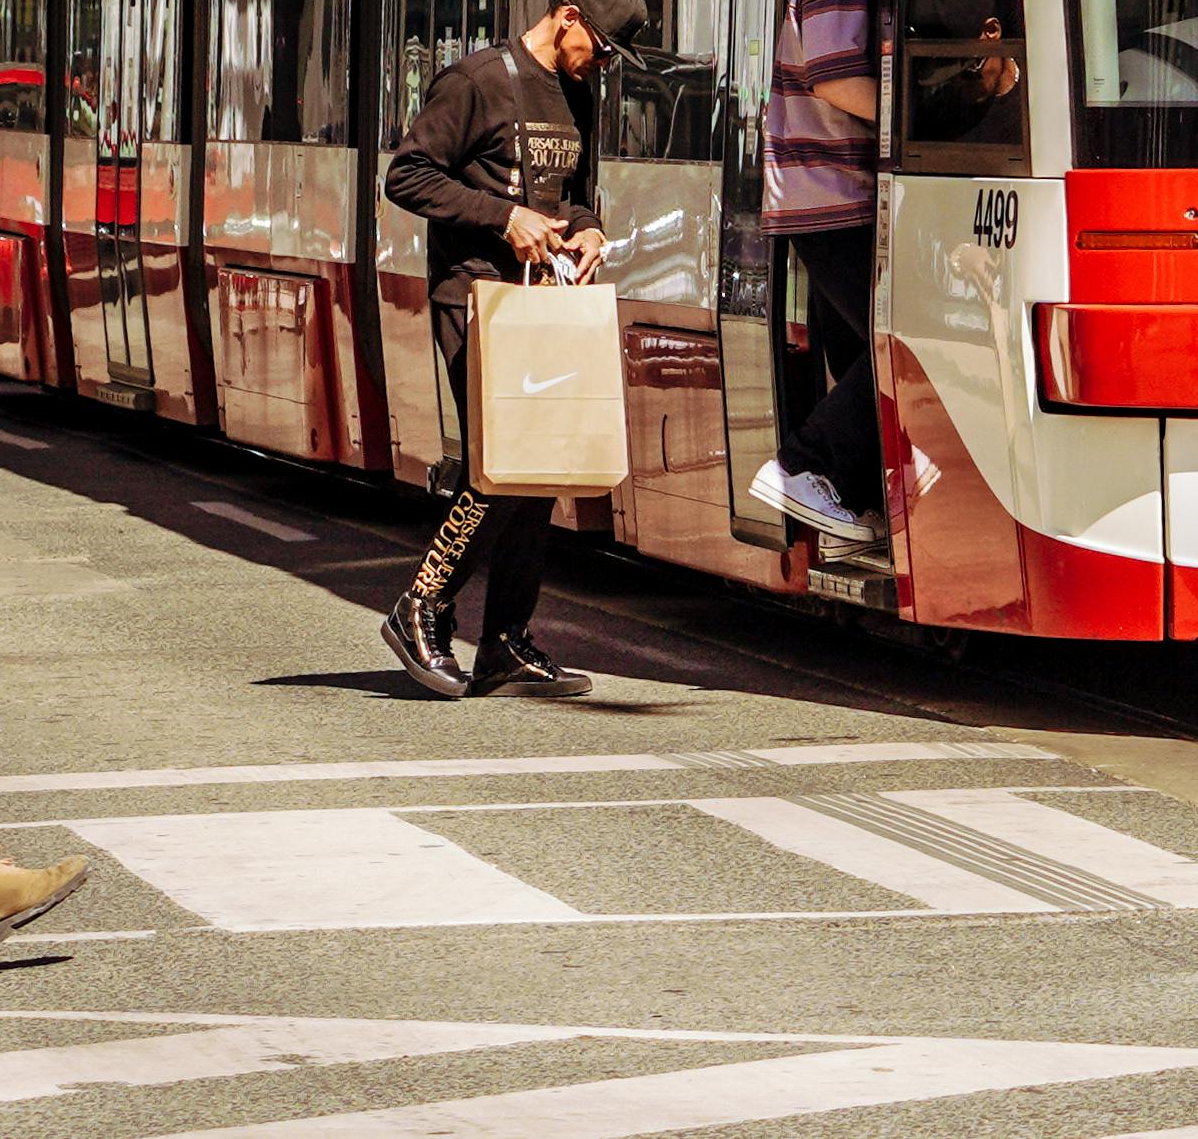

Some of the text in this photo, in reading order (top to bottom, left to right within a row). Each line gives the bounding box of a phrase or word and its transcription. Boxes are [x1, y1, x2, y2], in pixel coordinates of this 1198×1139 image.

[527, 137, 560, 150] VERSACE
[973, 189, 1019, 250] 4499
[412, 491, 474, 597] COUTURE
[446, 502, 489, 560] VERSACE
